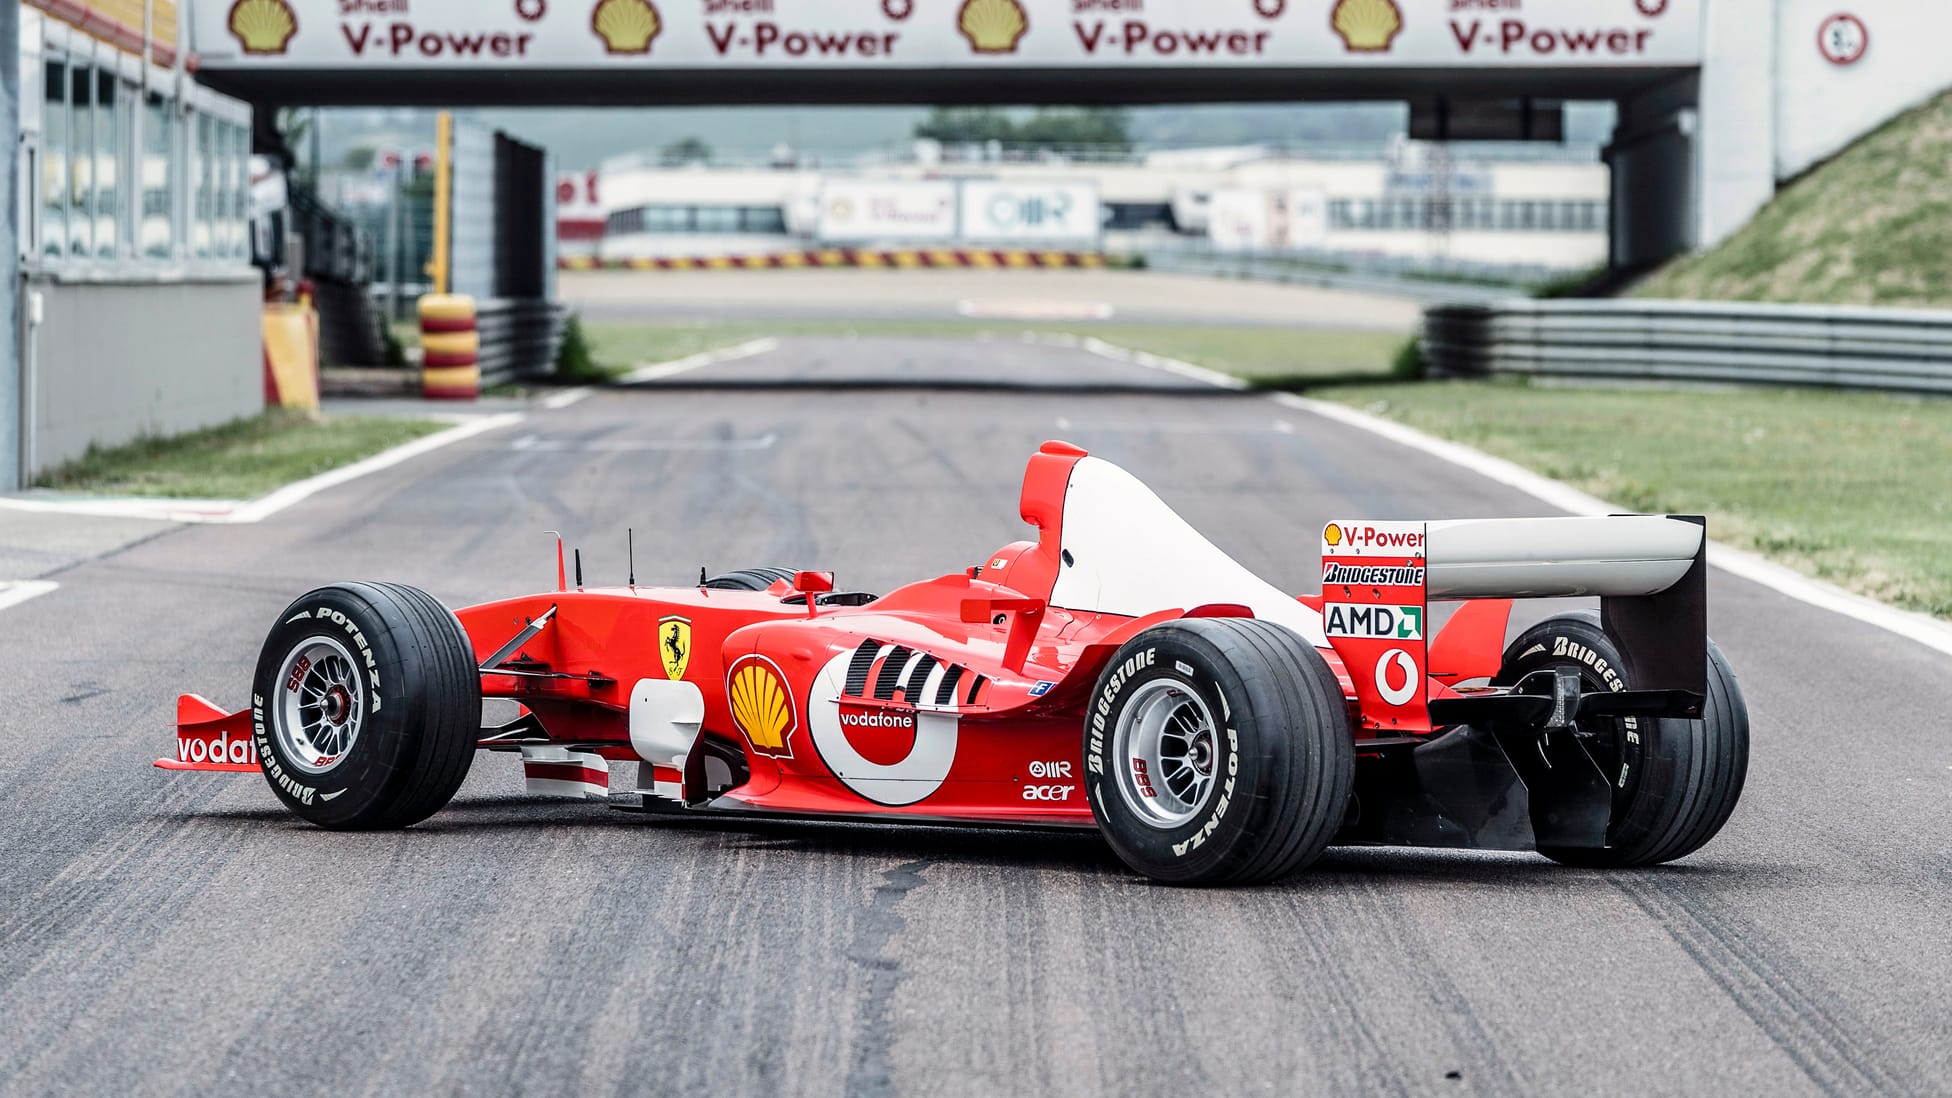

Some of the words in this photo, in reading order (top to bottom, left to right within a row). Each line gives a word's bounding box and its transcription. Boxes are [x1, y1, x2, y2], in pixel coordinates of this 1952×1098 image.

[341, 22, 536, 56] V-Power
[705, 22, 901, 56] V-Power
[1074, 21, 1271, 55] V-Power
[1450, 19, 1650, 54] V-Power
[1343, 527, 1424, 547] V-Power
[1322, 563, 1424, 584] BRIDGESTONE
[1326, 606, 1394, 636] AMD
[316, 607, 382, 714] POTENZA
[1552, 636, 1640, 745] BRIDGESNE
[840, 711, 912, 728] vodafone
[1087, 648, 1157, 776] BRIDGESTONE
[252, 693, 317, 806] BRIDGESTONE
[1022, 784, 1075, 801] acer
[1172, 728, 1238, 857] POTENZA
